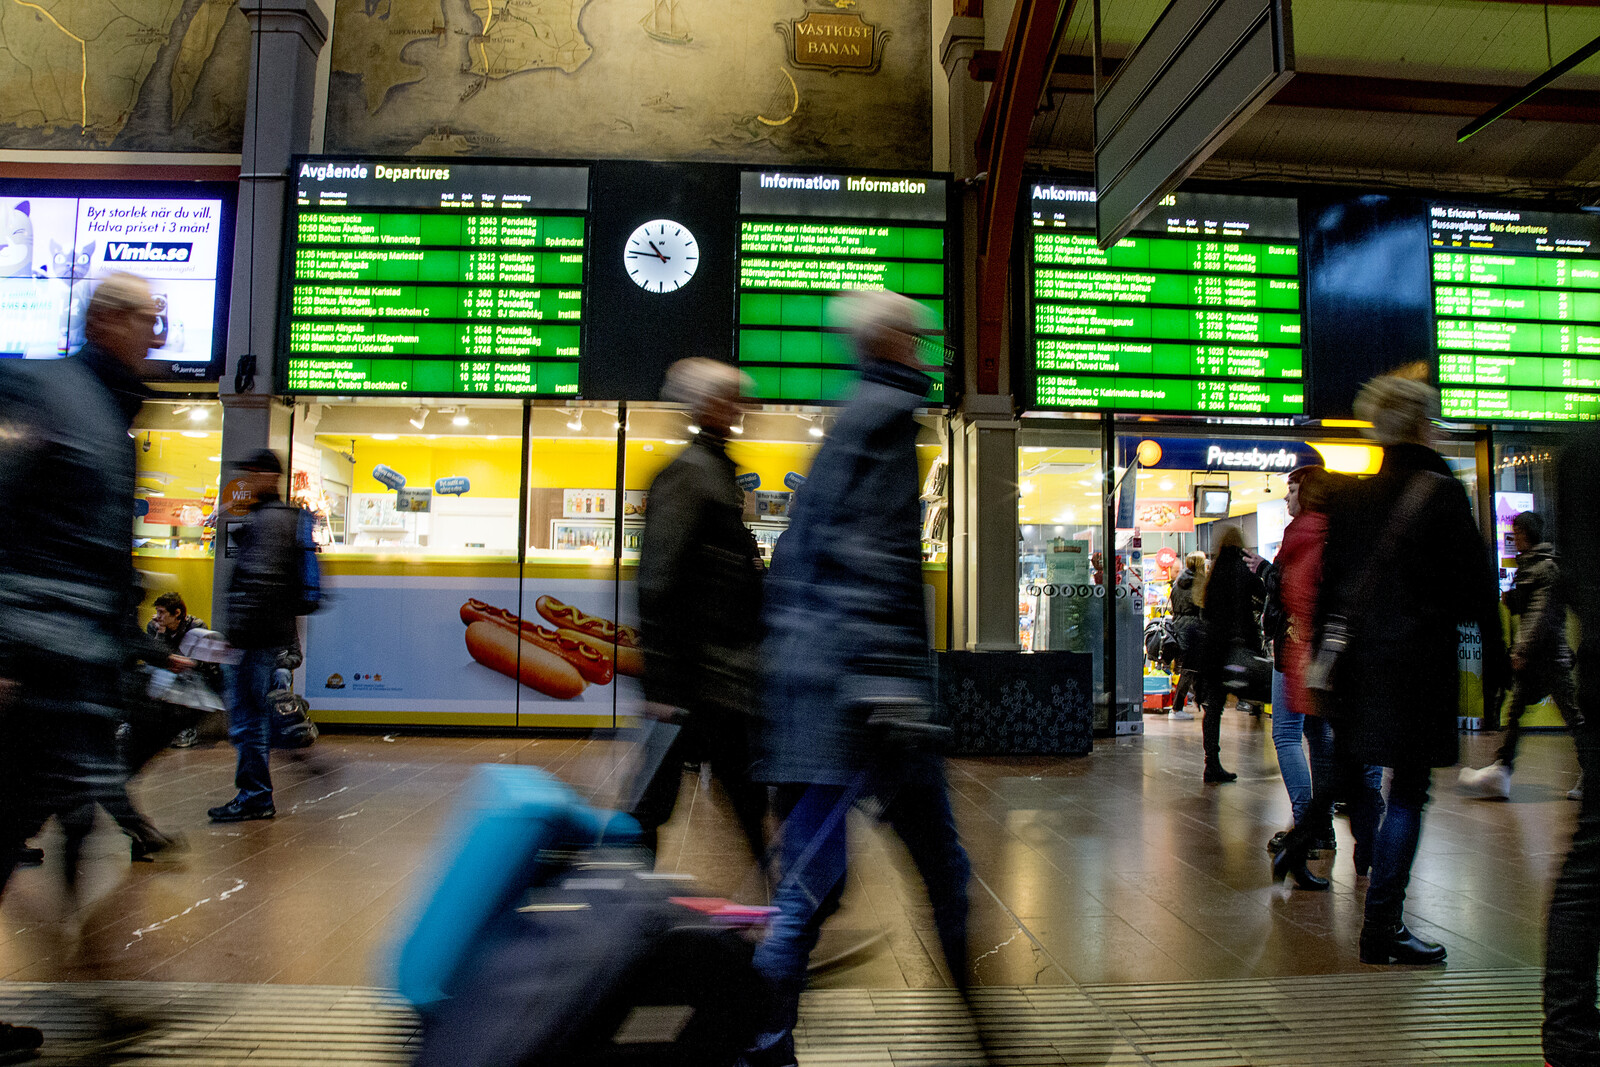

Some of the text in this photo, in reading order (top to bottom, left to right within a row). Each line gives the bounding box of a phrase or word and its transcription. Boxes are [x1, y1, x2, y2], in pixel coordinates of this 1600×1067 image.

[808, 42, 859, 55] BANAN
[300, 163, 450, 182] Avgående Departures
[760, 174, 925, 193] Information Information
[1033, 186, 1096, 202] Ankomma
[88, 207, 212, 218] Byt storlek när du vill.
[1431, 208, 1520, 221] Nils Ericson Terminalen
[319, 215, 361, 224] Kungsbacka
[502, 217, 536, 227] Pendeltåg
[1432, 220, 1548, 234] Bussavgångar Bus departures
[88, 222, 209, 234] Halva priset i 3 mån!
[298, 224, 317, 232] 10:50
[342, 224, 374, 234] Älvängen
[501, 227, 536, 236] Pendeltåg
[753, 224, 867, 236] grund den rådande väderleken
[298, 234, 317, 242] 11:00
[318, 234, 340, 242] Bohus
[343, 235, 379, 243] Trollhättan
[381, 235, 420, 245] Vänersborg
[546, 238, 583, 248] Spårändrat
[761, 234, 795, 244] störningar
[1035, 235, 1284, 254] 10:40 Oslo Buss
[109, 242, 188, 261] Vimla.se
[742, 243, 769, 251] sträckor
[794, 244, 830, 254] avstängda
[1054, 245, 1256, 263] Alingsås Pendeltåg
[317, 251, 352, 260] Herrljunga
[354, 252, 387, 261] Lidköping
[389, 252, 424, 260] Mariestad
[478, 253, 495, 261] 3312
[560, 255, 582, 263] Inställt
[1054, 254, 1256, 273] Älvängen Bohus Pendeltåg
[340, 261, 368, 270] Alingsås
[500, 263, 535, 273] Pendeltåg
[771, 259, 804, 270] avgångar
[820, 261, 845, 271] kraftiga
[296, 270, 534, 283] 11:15 Kungsbacka Pendeltåg
[741, 268, 818, 279] Störningarna beräknas
[1055, 270, 1285, 289] Mariestad Lidköping Herrljunga Buss
[811, 280, 840, 289] kontakta
[1035, 280, 1151, 292] 11:00 Vänersborg Trollhättan Bohus
[315, 287, 351, 295] Trollhättan
[353, 287, 370, 295] Åmål
[372, 288, 401, 296] Karlstad
[509, 290, 540, 299] Regional
[559, 291, 581, 299] Inställt
[1055, 289, 1146, 303] Nässjö Jönköping Falköping
[314, 297, 336, 305] Bohus
[338, 296, 370, 306] Älvängen
[498, 300, 533, 309] Pendeltåg
[314, 307, 580, 319] Skövde Södertälje Stockholm Snabbtåg Inställt
[1056, 306, 1258, 323] Kungsbacka Pendeltåg
[1056, 316, 1089, 324] Uddevalla
[1090, 317, 1133, 327] Stenungsund
[312, 324, 532, 336] Lerum Alingsås Pendeltåg
[1055, 325, 1258, 342] Alingsås Lerum Pendeltåg
[311, 334, 541, 346] Malmö Cph Airport Köpenhamn Öresundståg
[311, 343, 357, 353] Stenungsund
[358, 344, 393, 352] Uddevalla
[557, 347, 579, 356] Inställt
[1056, 342, 1268, 358] Köpenhamn Malmö Halmstad Öresundståg
[1056, 350, 1260, 367] Älvängen Bohus Pendeltåg
[310, 361, 530, 373] Kungsbacka Pendeltåg
[1056, 361, 1075, 369] Luleå
[1076, 362, 1098, 370] Duved
[309, 370, 530, 383] Bohus Älvängen Pendeltåg
[1057, 377, 1077, 386] Borås
[309, 380, 578, 393] Skövde Örebro Stockholm Regional Inställt
[1057, 388, 1092, 396] Stockholm
[1100, 388, 1139, 397] Katrineholm
[1141, 390, 1165, 398] Skövde
[1239, 393, 1270, 403] Snabbtåg
[1057, 397, 1261, 412] Kungsbacka Pendeltåg
[1207, 446, 1297, 470] Pressbyrån
[1460, 631, 1480, 644] behö
